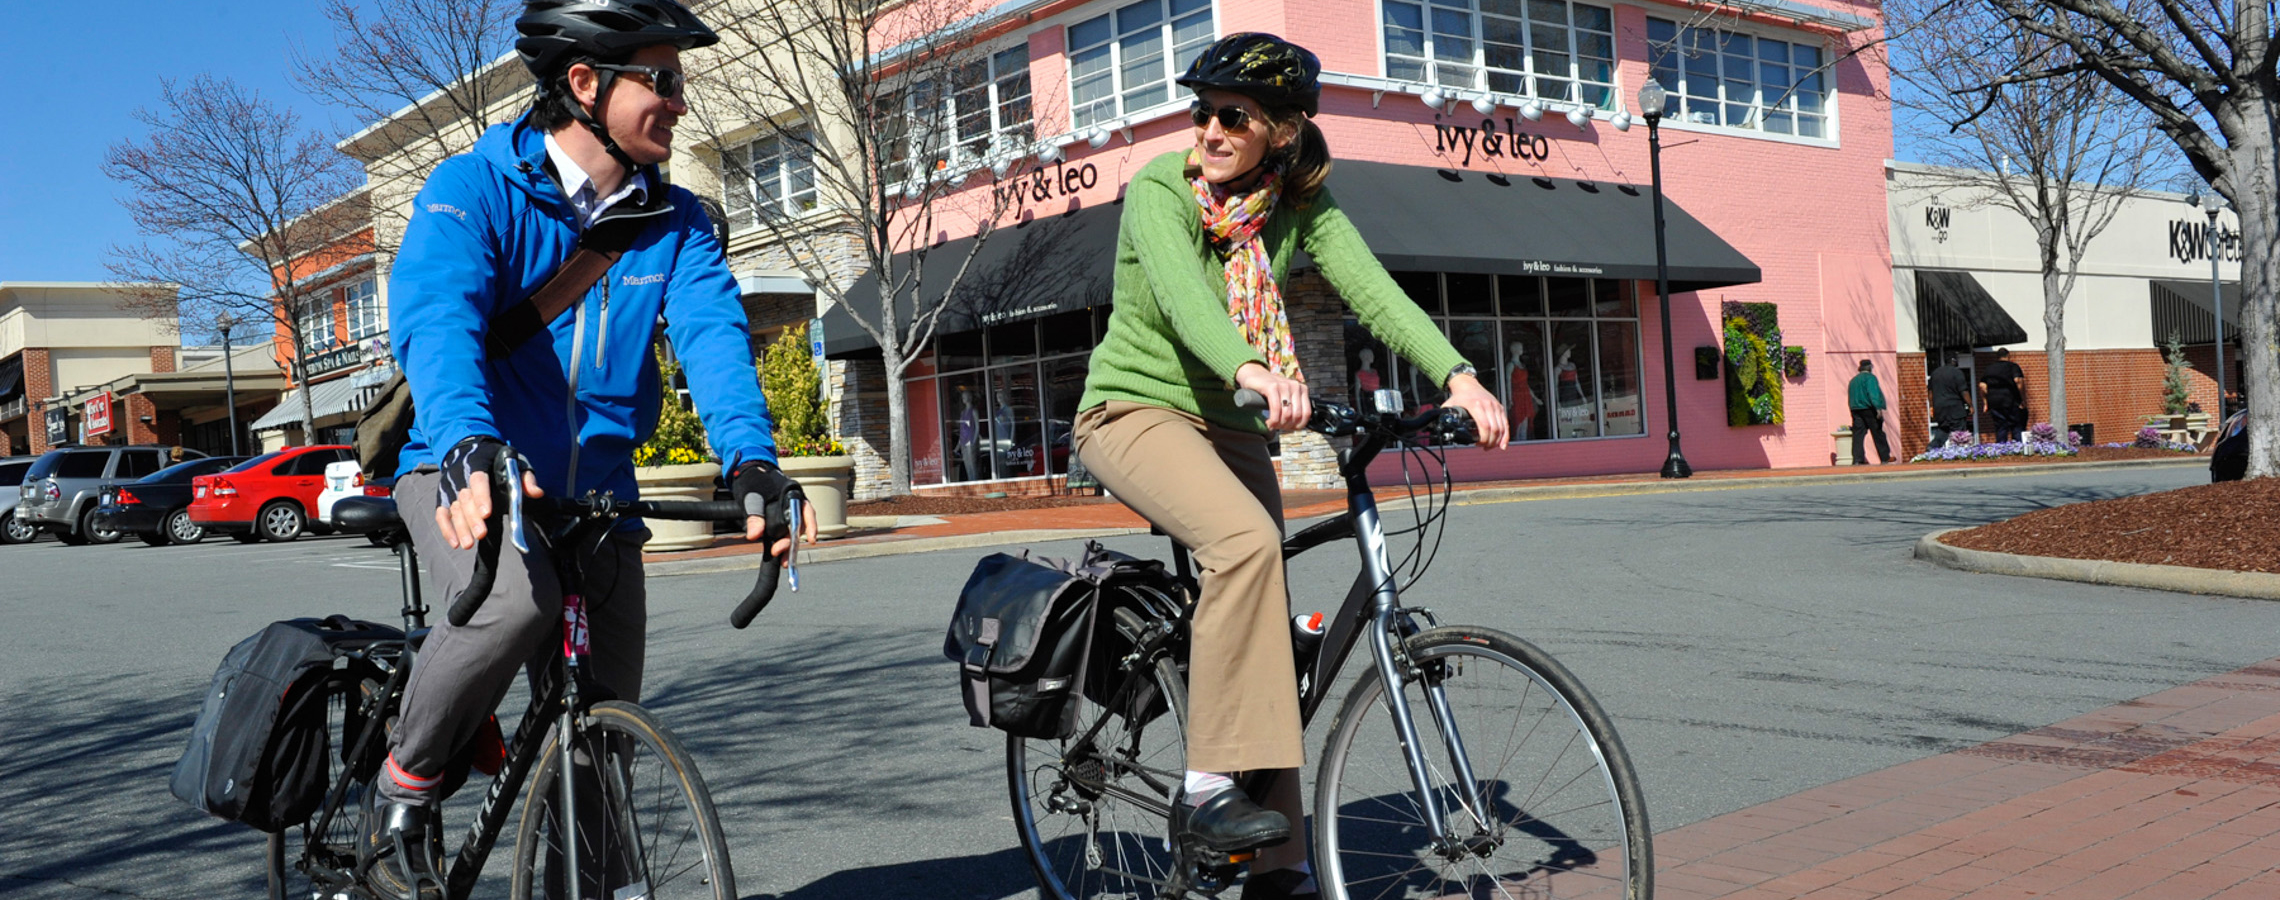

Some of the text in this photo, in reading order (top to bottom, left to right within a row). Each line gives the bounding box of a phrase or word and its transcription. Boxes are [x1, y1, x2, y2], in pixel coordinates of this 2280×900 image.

[1434, 113, 1549, 168] ivy & leo
[992, 157, 1097, 220] ivy & leo
[1926, 206, 1950, 230] K&W
[2169, 219, 2207, 264] K&W
[1523, 260, 1533, 274] ivy
[1533, 260, 1540, 272] &
[1540, 260, 1551, 272] leo
[622, 273, 666, 286] Marmot
[1023, 446, 1034, 457] leo
